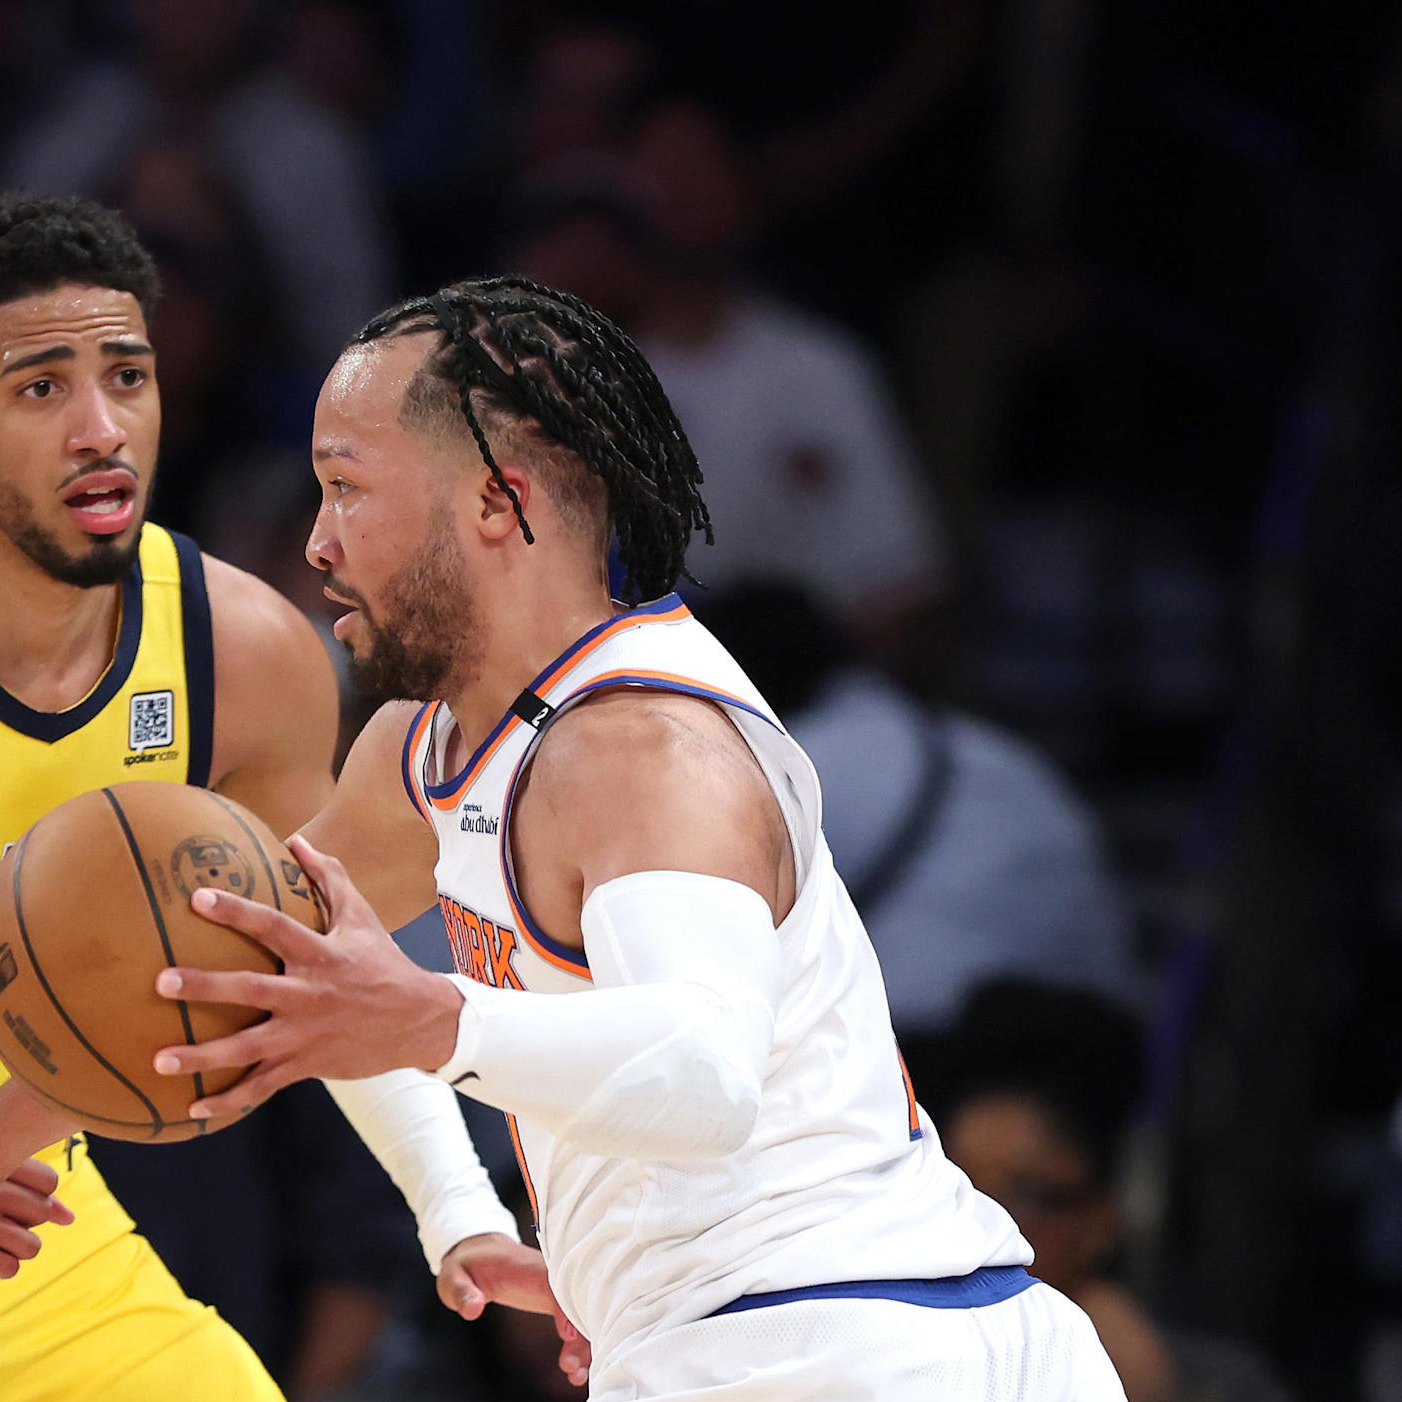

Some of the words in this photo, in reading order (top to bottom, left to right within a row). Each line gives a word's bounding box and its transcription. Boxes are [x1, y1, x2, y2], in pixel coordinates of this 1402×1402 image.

[531, 706, 549, 727] 2
[460, 814, 474, 832] abu
[438, 891, 528, 992] YORK
